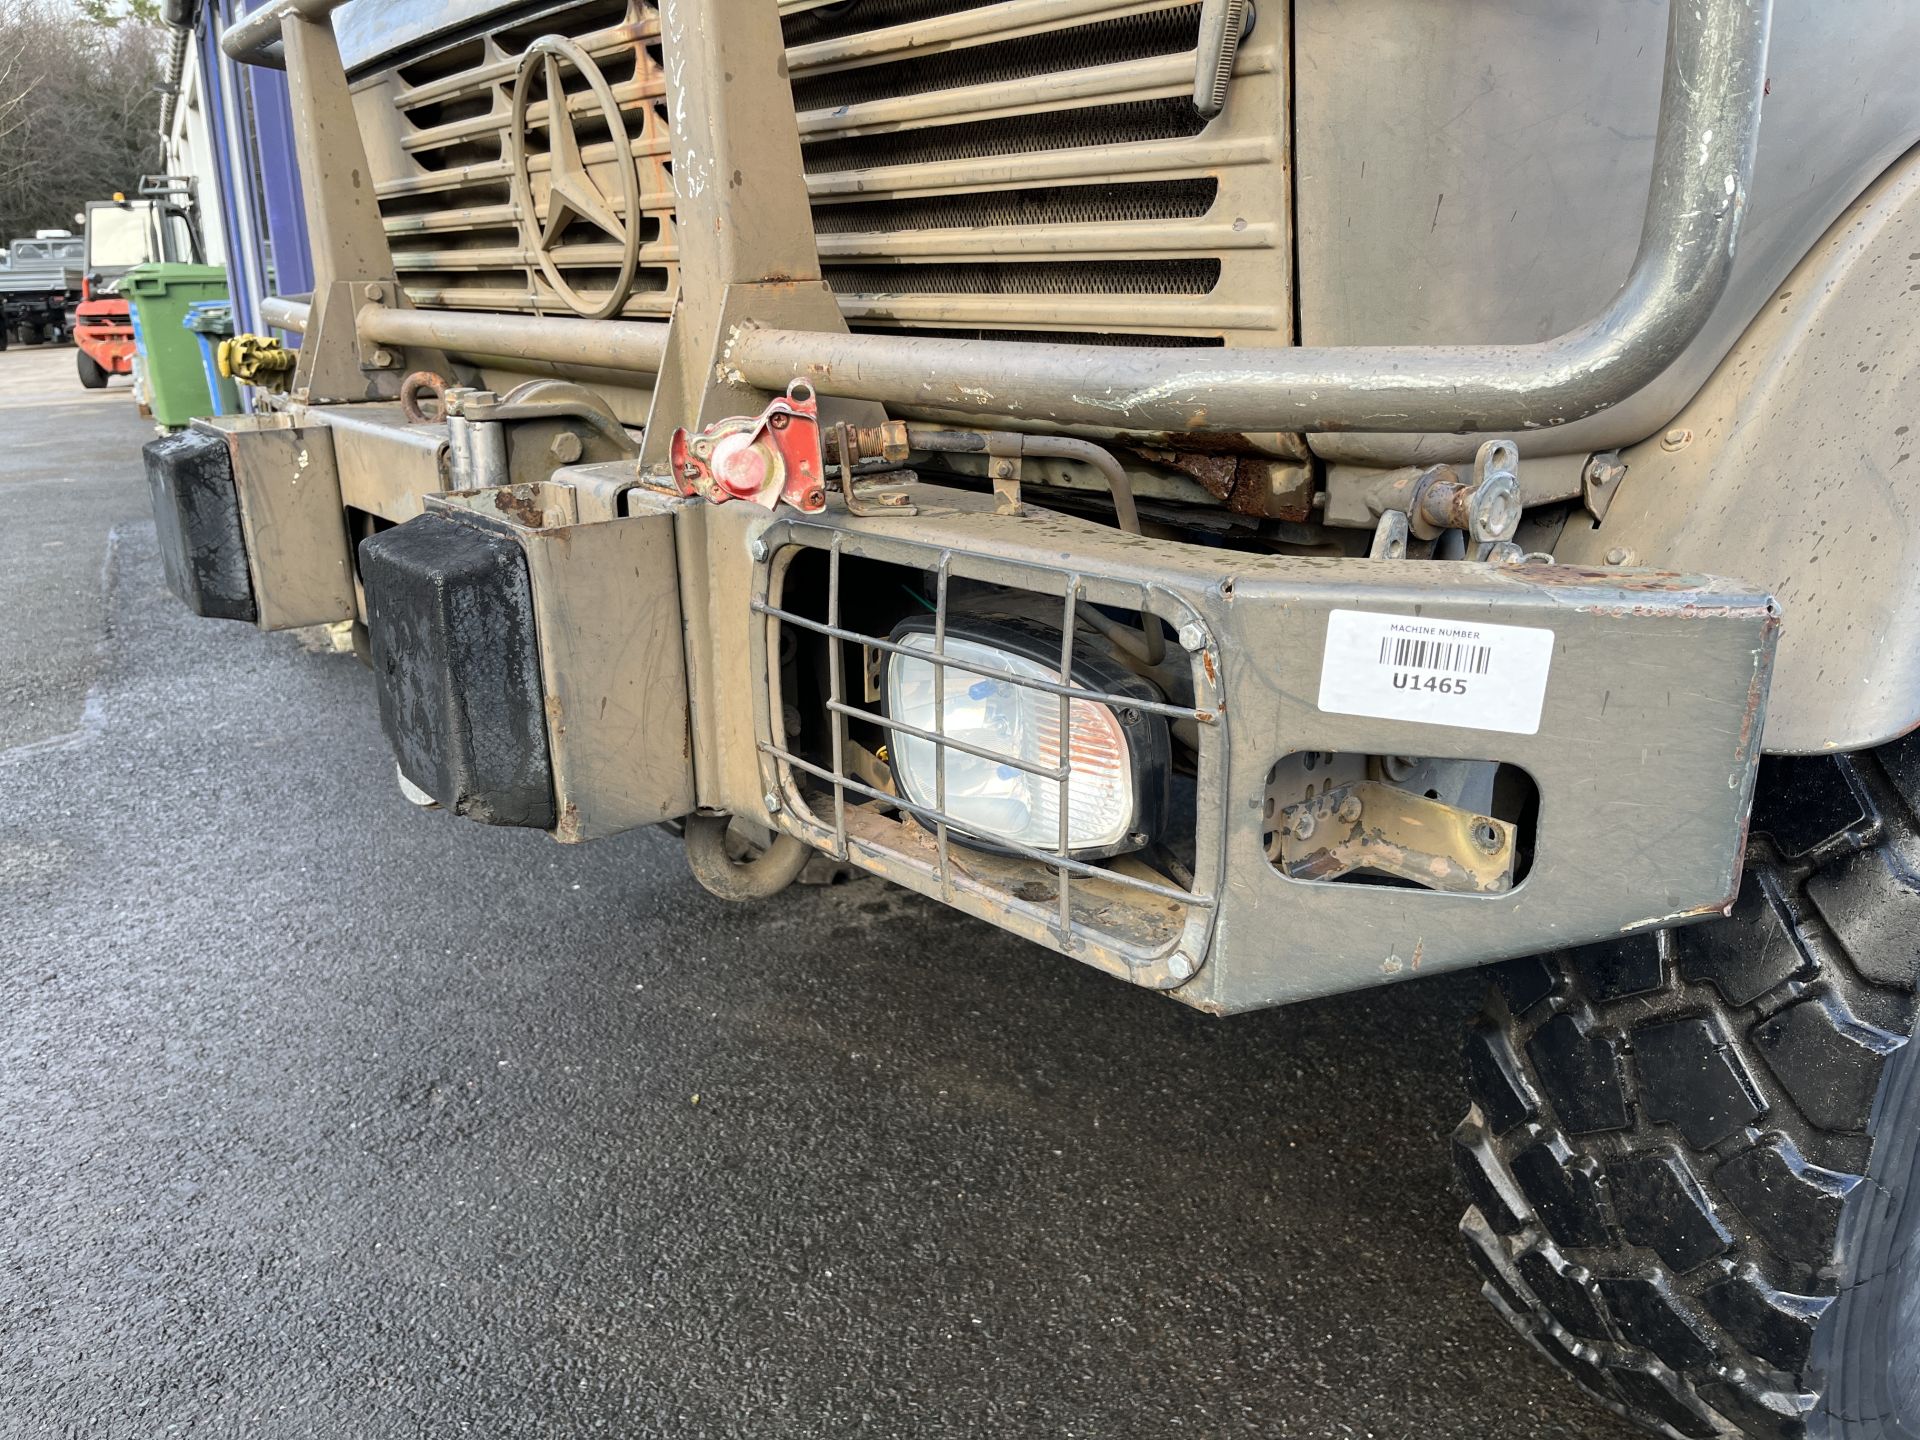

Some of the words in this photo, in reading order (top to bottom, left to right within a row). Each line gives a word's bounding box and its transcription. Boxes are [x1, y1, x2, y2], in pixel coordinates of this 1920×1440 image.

[1390, 623, 1436, 635] MACHINE
[1439, 628, 1480, 639] NUMBER
[1393, 672, 1468, 695] U1465
